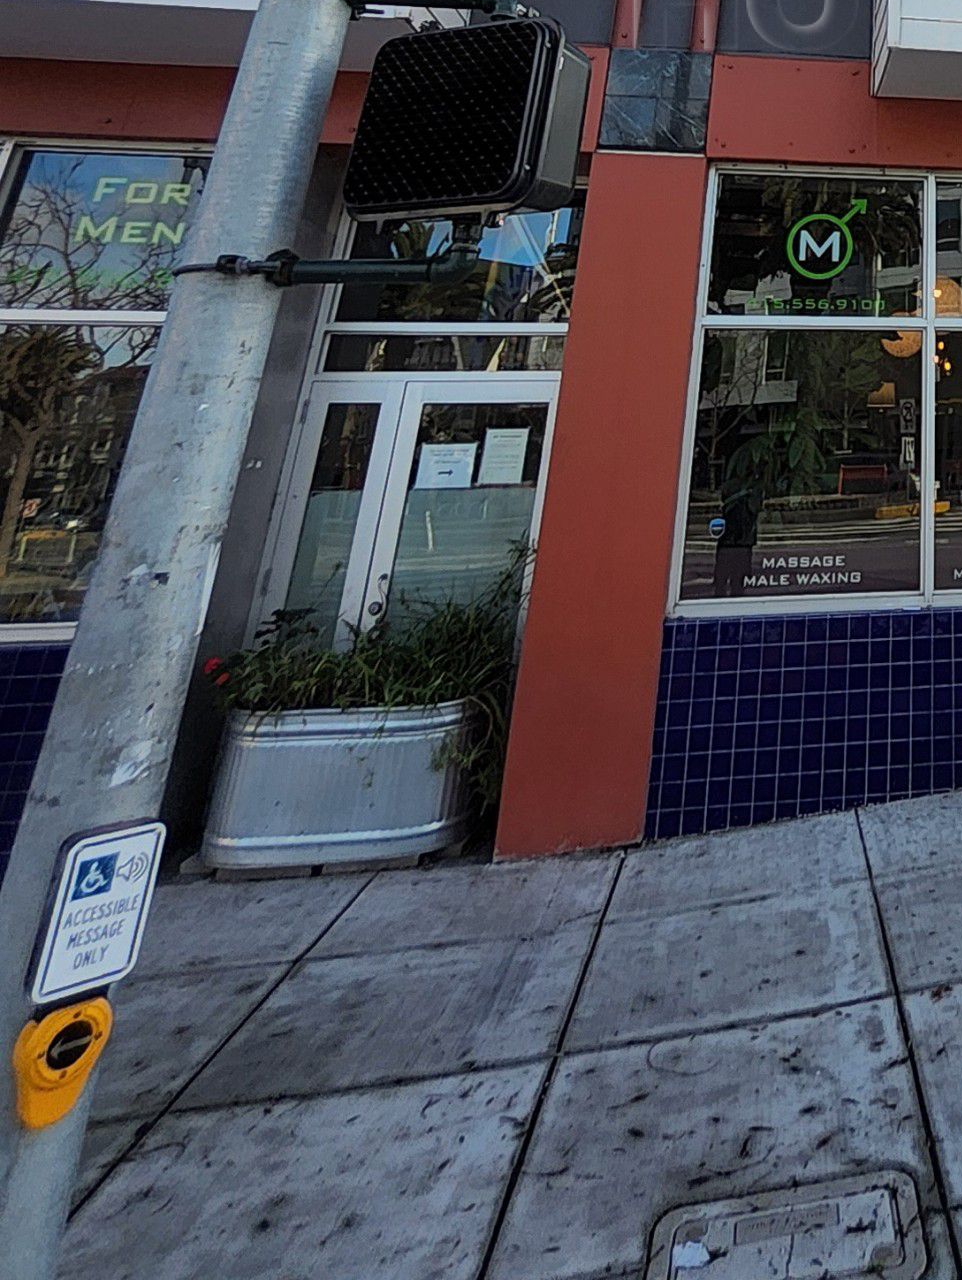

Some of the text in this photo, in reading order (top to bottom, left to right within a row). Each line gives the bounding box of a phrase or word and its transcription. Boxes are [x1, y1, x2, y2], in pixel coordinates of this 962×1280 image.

[92, 177, 191, 205] FOR
[73, 216, 185, 244] MEN
[799, 230, 840, 262] M
[762, 555, 846, 569] MASSAGE
[743, 572, 862, 587] MALE WAXING
[63, 893, 140, 930] ACCESSIBLE
[66, 918, 126, 951] MESSAGE
[72, 943, 110, 970] ONLY
